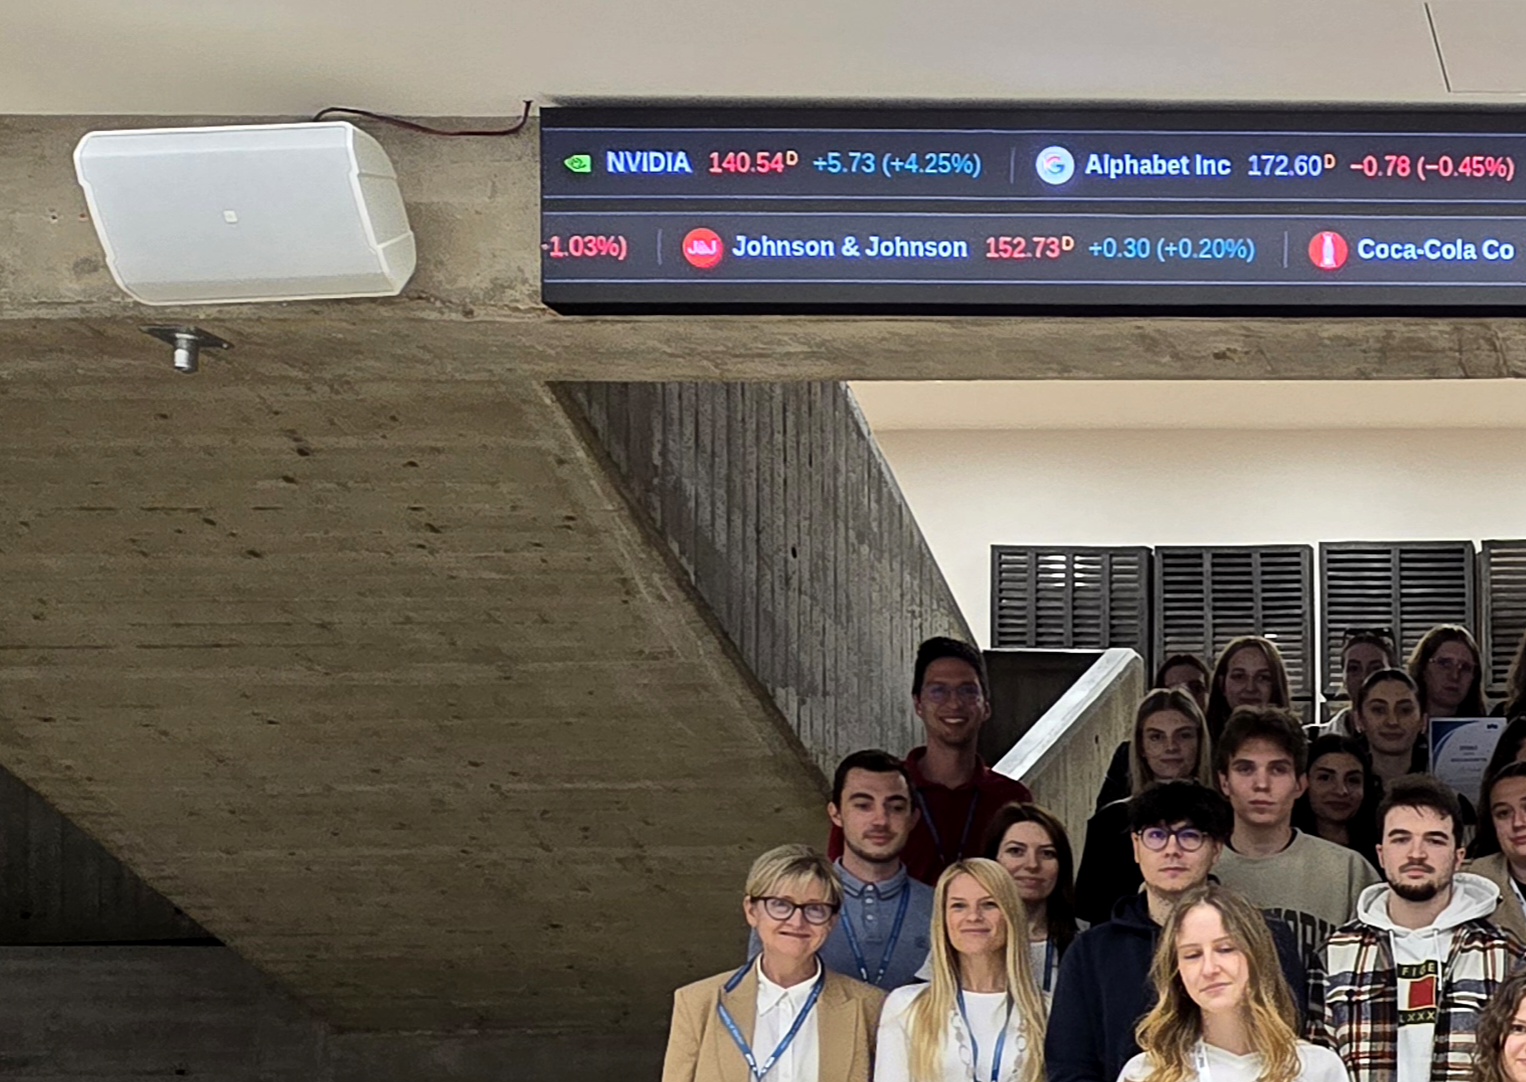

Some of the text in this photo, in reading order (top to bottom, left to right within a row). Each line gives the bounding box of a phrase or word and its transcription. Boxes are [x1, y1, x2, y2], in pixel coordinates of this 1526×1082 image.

[606, 151, 694, 176] NVIDIA
[813, 152, 875, 174] +5.73
[881, 153, 982, 179] (+4.25%)
[1085, 153, 1190, 180] Alphabet
[1194, 154, 1232, 179] Inc
[1349, 155, 1411, 178] -0.78
[1417, 156, 1515, 182] (-0.45%)
[732, 235, 837, 261] Johnson
[842, 236, 862, 260] &
[866, 235, 970, 261] Johnson
[1088, 237, 1150, 260] +0.30
[1157, 237, 1258, 264] (+0.20%)
[1357, 237, 1476, 263] Coca-Cola
[1480, 239, 1515, 263] Co
